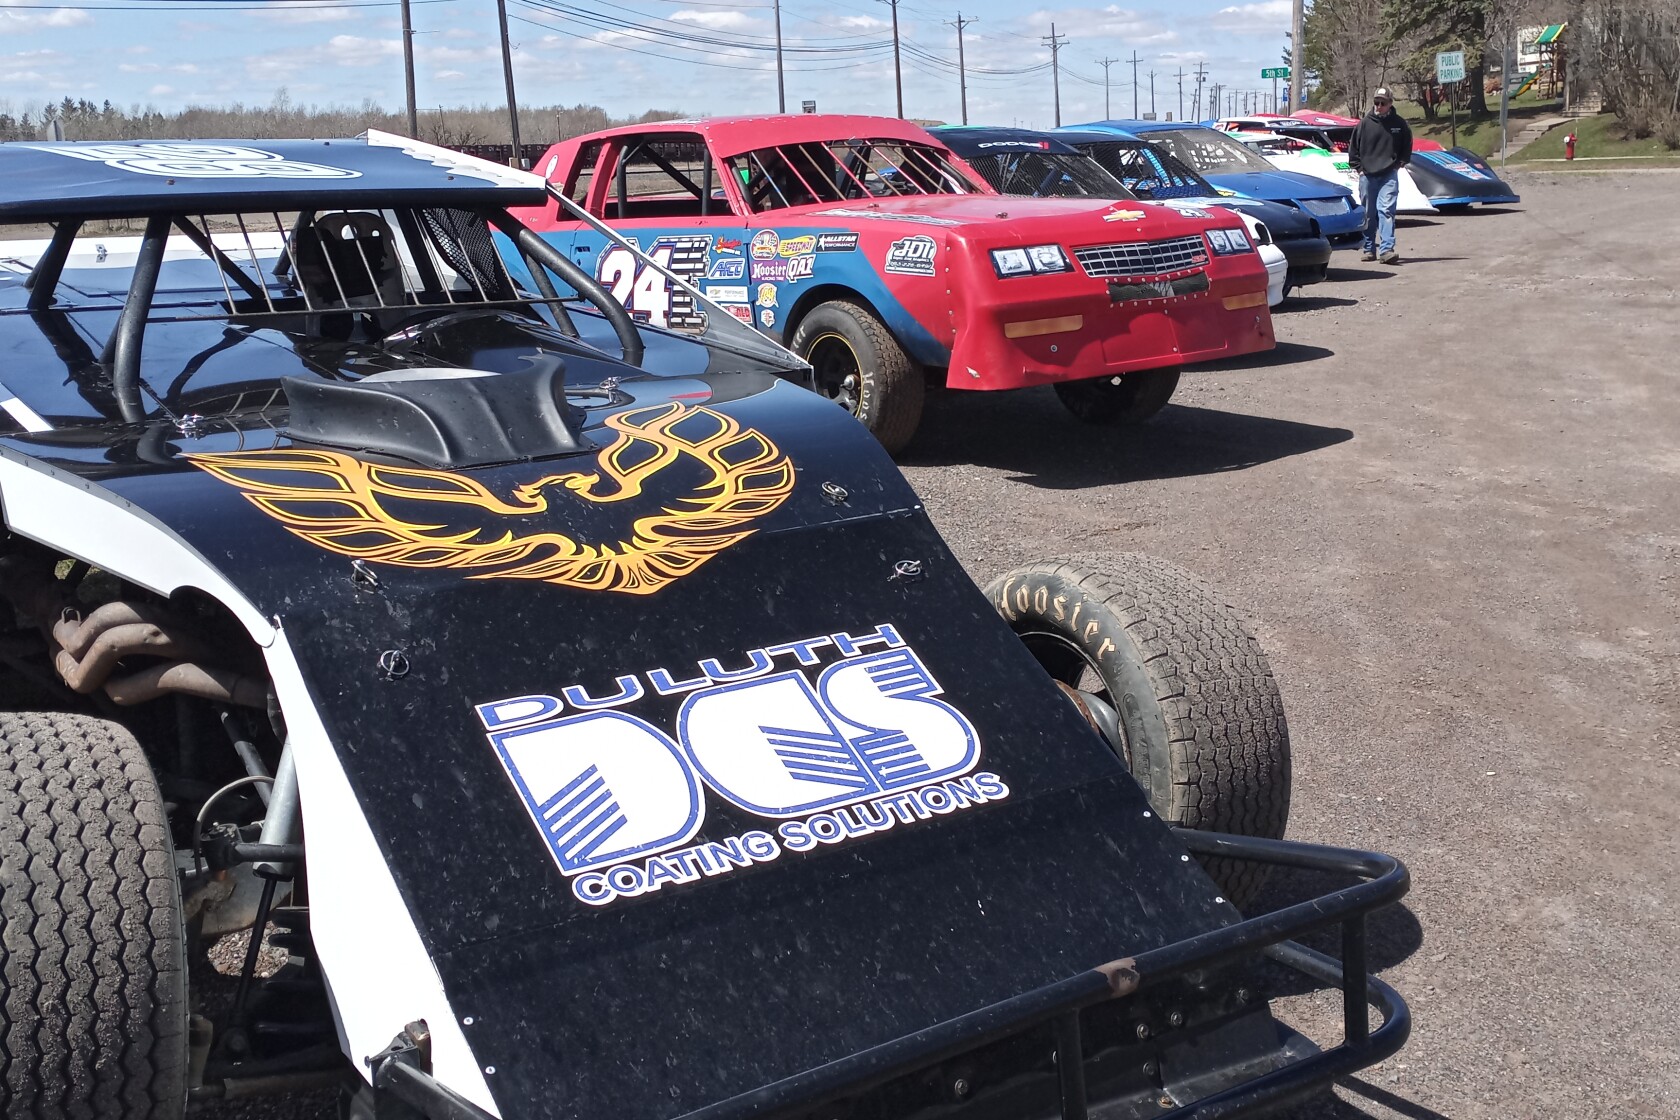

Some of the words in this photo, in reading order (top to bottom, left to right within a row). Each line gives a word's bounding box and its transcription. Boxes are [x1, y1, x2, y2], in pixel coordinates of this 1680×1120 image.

[1441, 55, 1460, 66] PUBLIC
[1266, 70, 1276, 78] 5th
[1277, 69, 1284, 77] St
[1440, 68, 1463, 79] PARKING
[751, 261, 786, 278] Hoosier
[790, 257, 813, 281] QA1
[596, 243, 674, 329] 24
[475, 623, 905, 731] DULUTH
[486, 645, 981, 876] DCS
[571, 832, 776, 905] COATING
[777, 772, 1009, 853] SOLUTIONS
